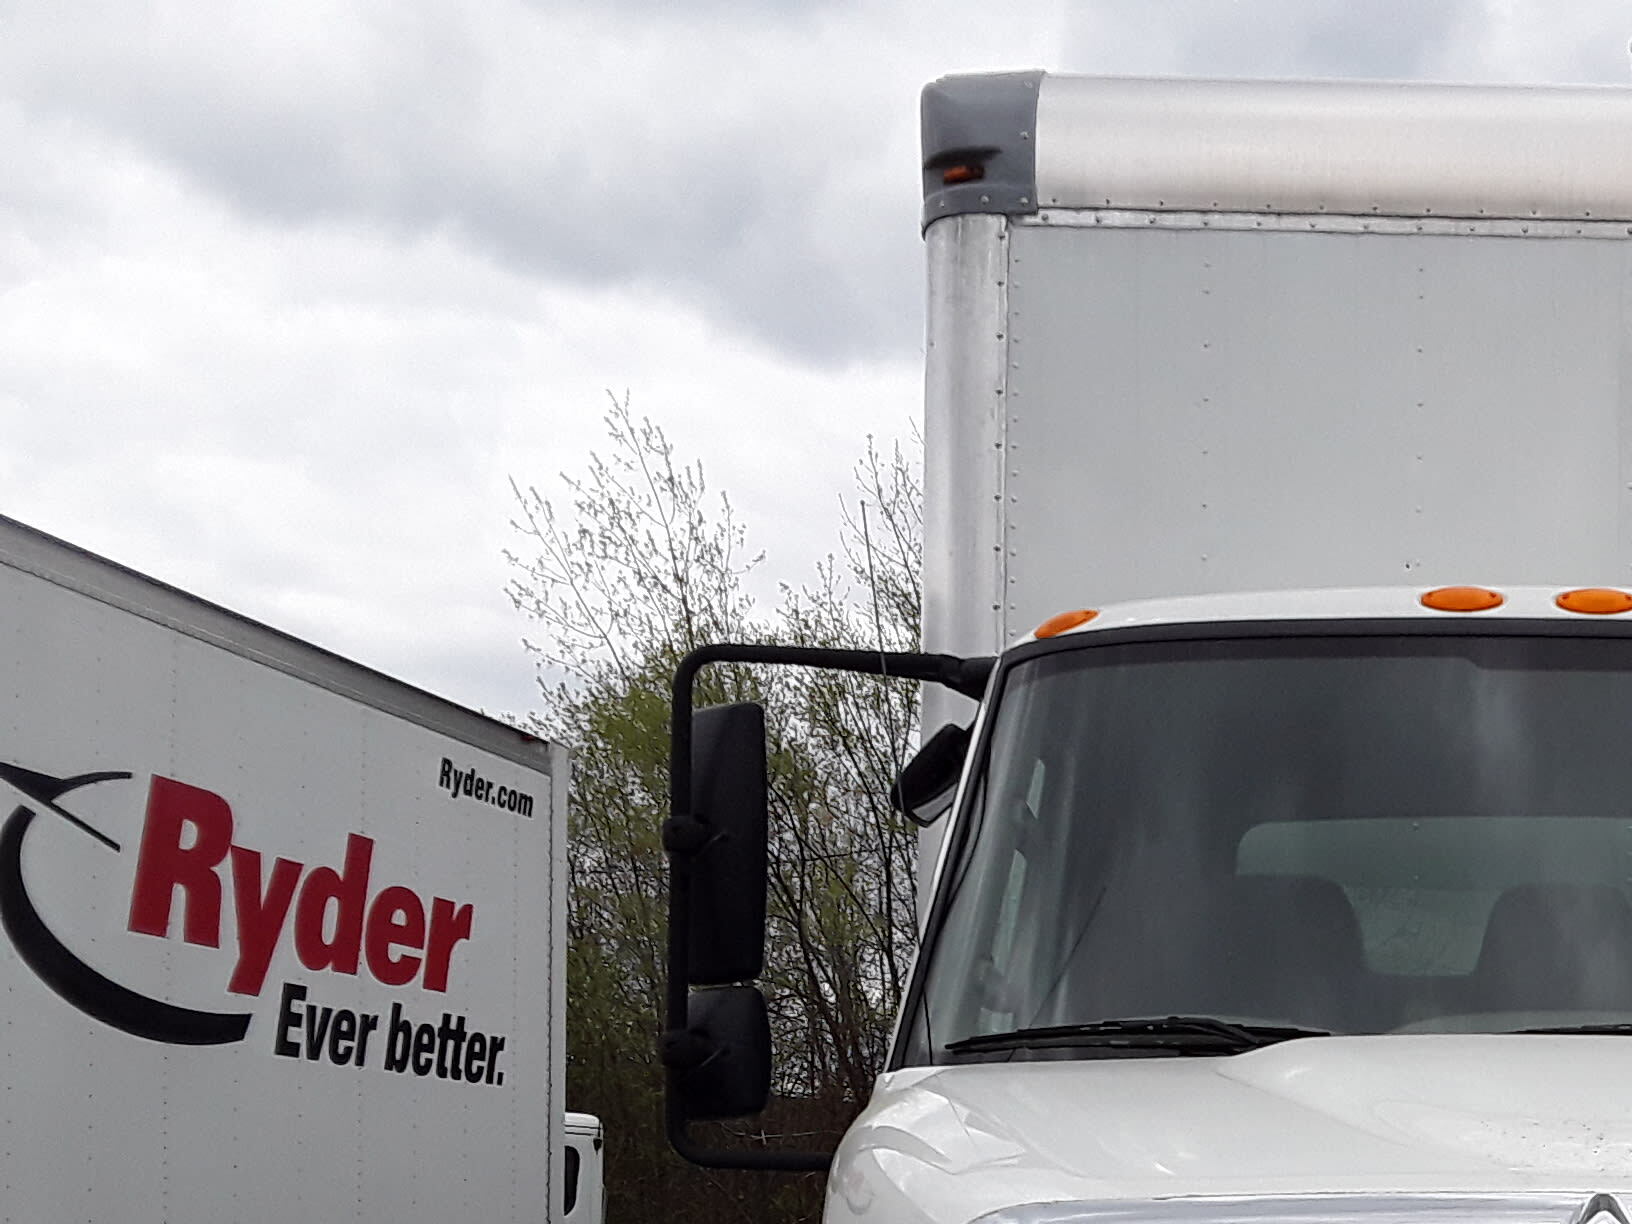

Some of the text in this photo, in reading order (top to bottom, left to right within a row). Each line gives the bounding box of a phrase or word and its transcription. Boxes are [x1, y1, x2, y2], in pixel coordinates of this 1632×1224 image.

[439, 757, 534, 818] Ryder.com
[127, 774, 474, 997] Ryder
[274, 983, 506, 1086] Ever better.
